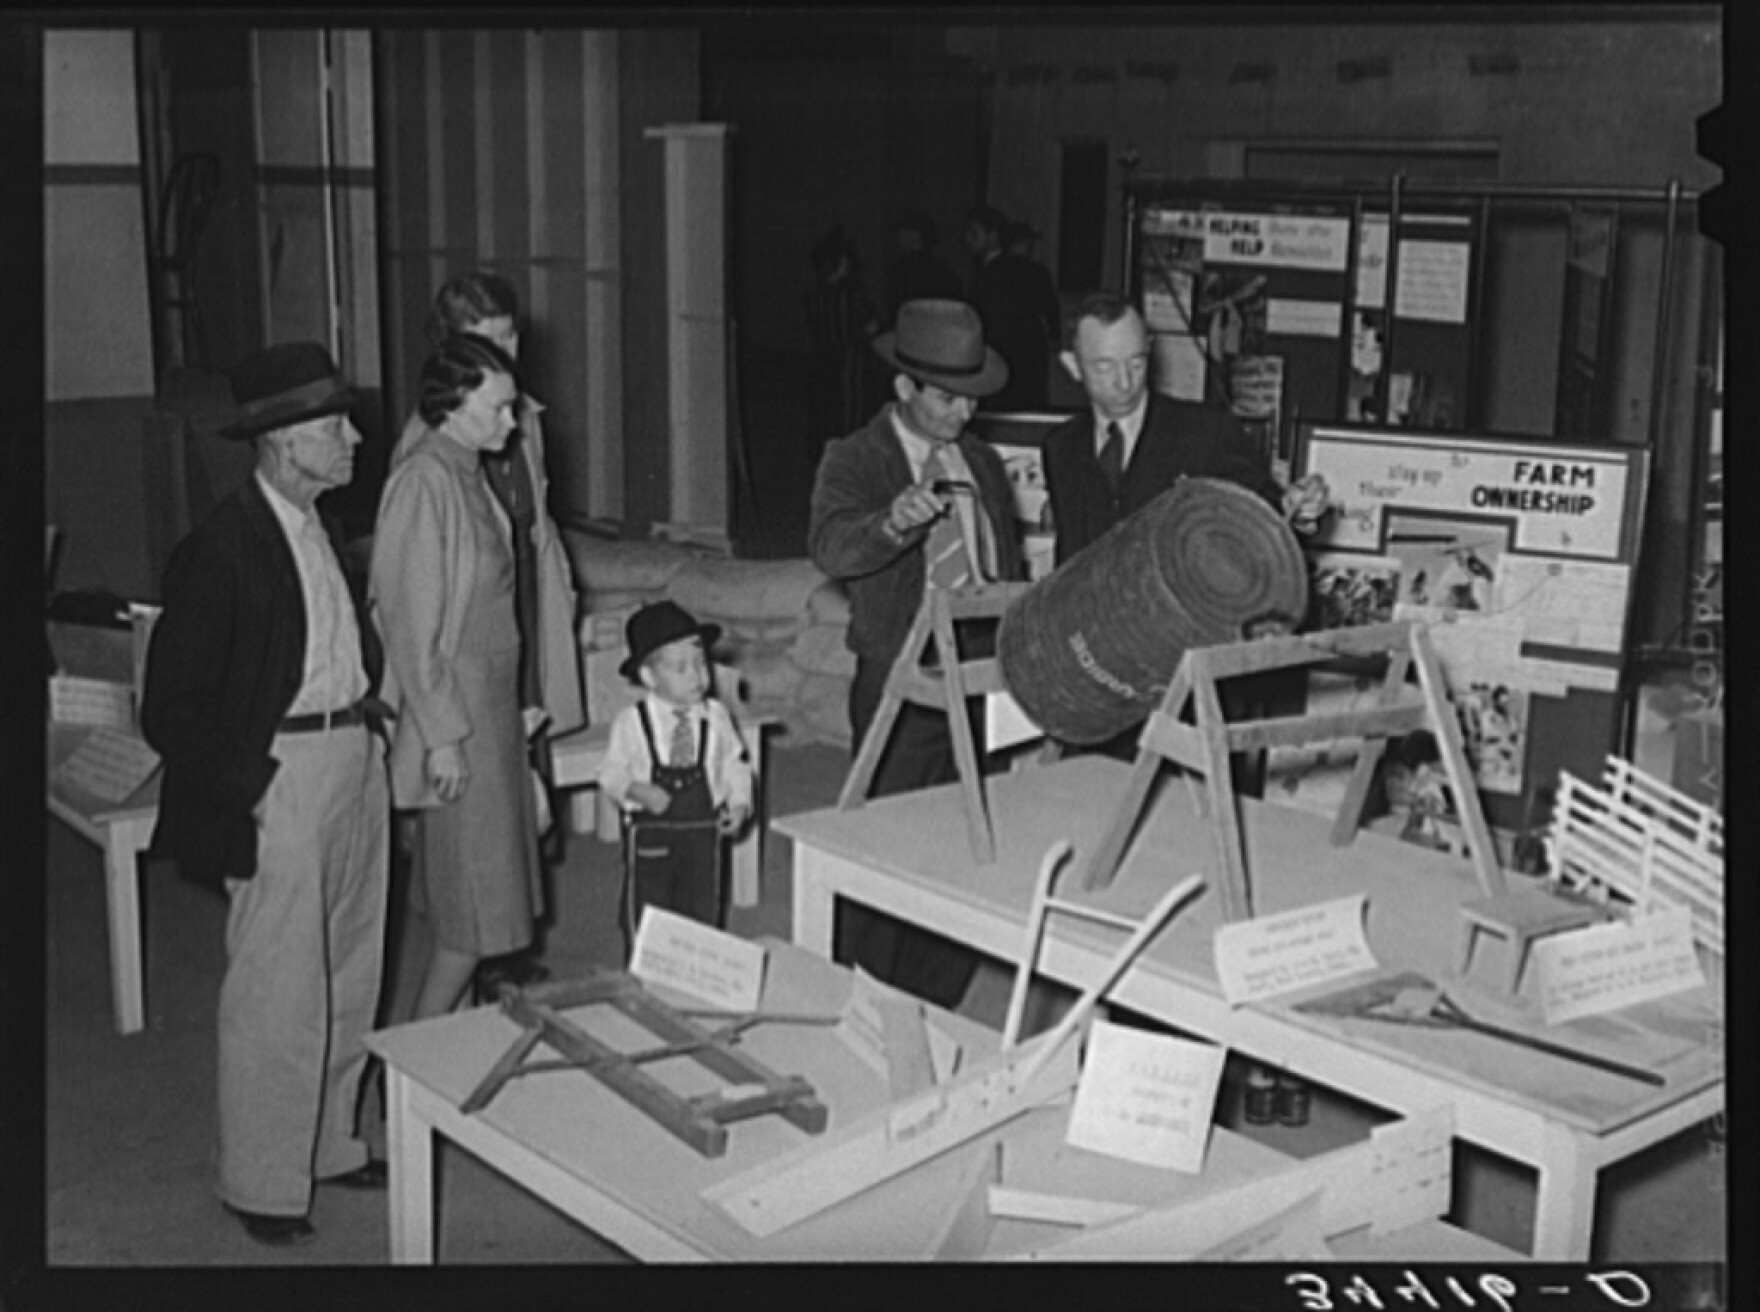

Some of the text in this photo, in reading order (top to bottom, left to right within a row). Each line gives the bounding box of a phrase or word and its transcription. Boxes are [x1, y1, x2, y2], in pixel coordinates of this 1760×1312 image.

[1229, 237, 1264, 257] HELP
[1512, 460, 1596, 490] FARM
[1470, 484, 1596, 517] OWNERSHIP
